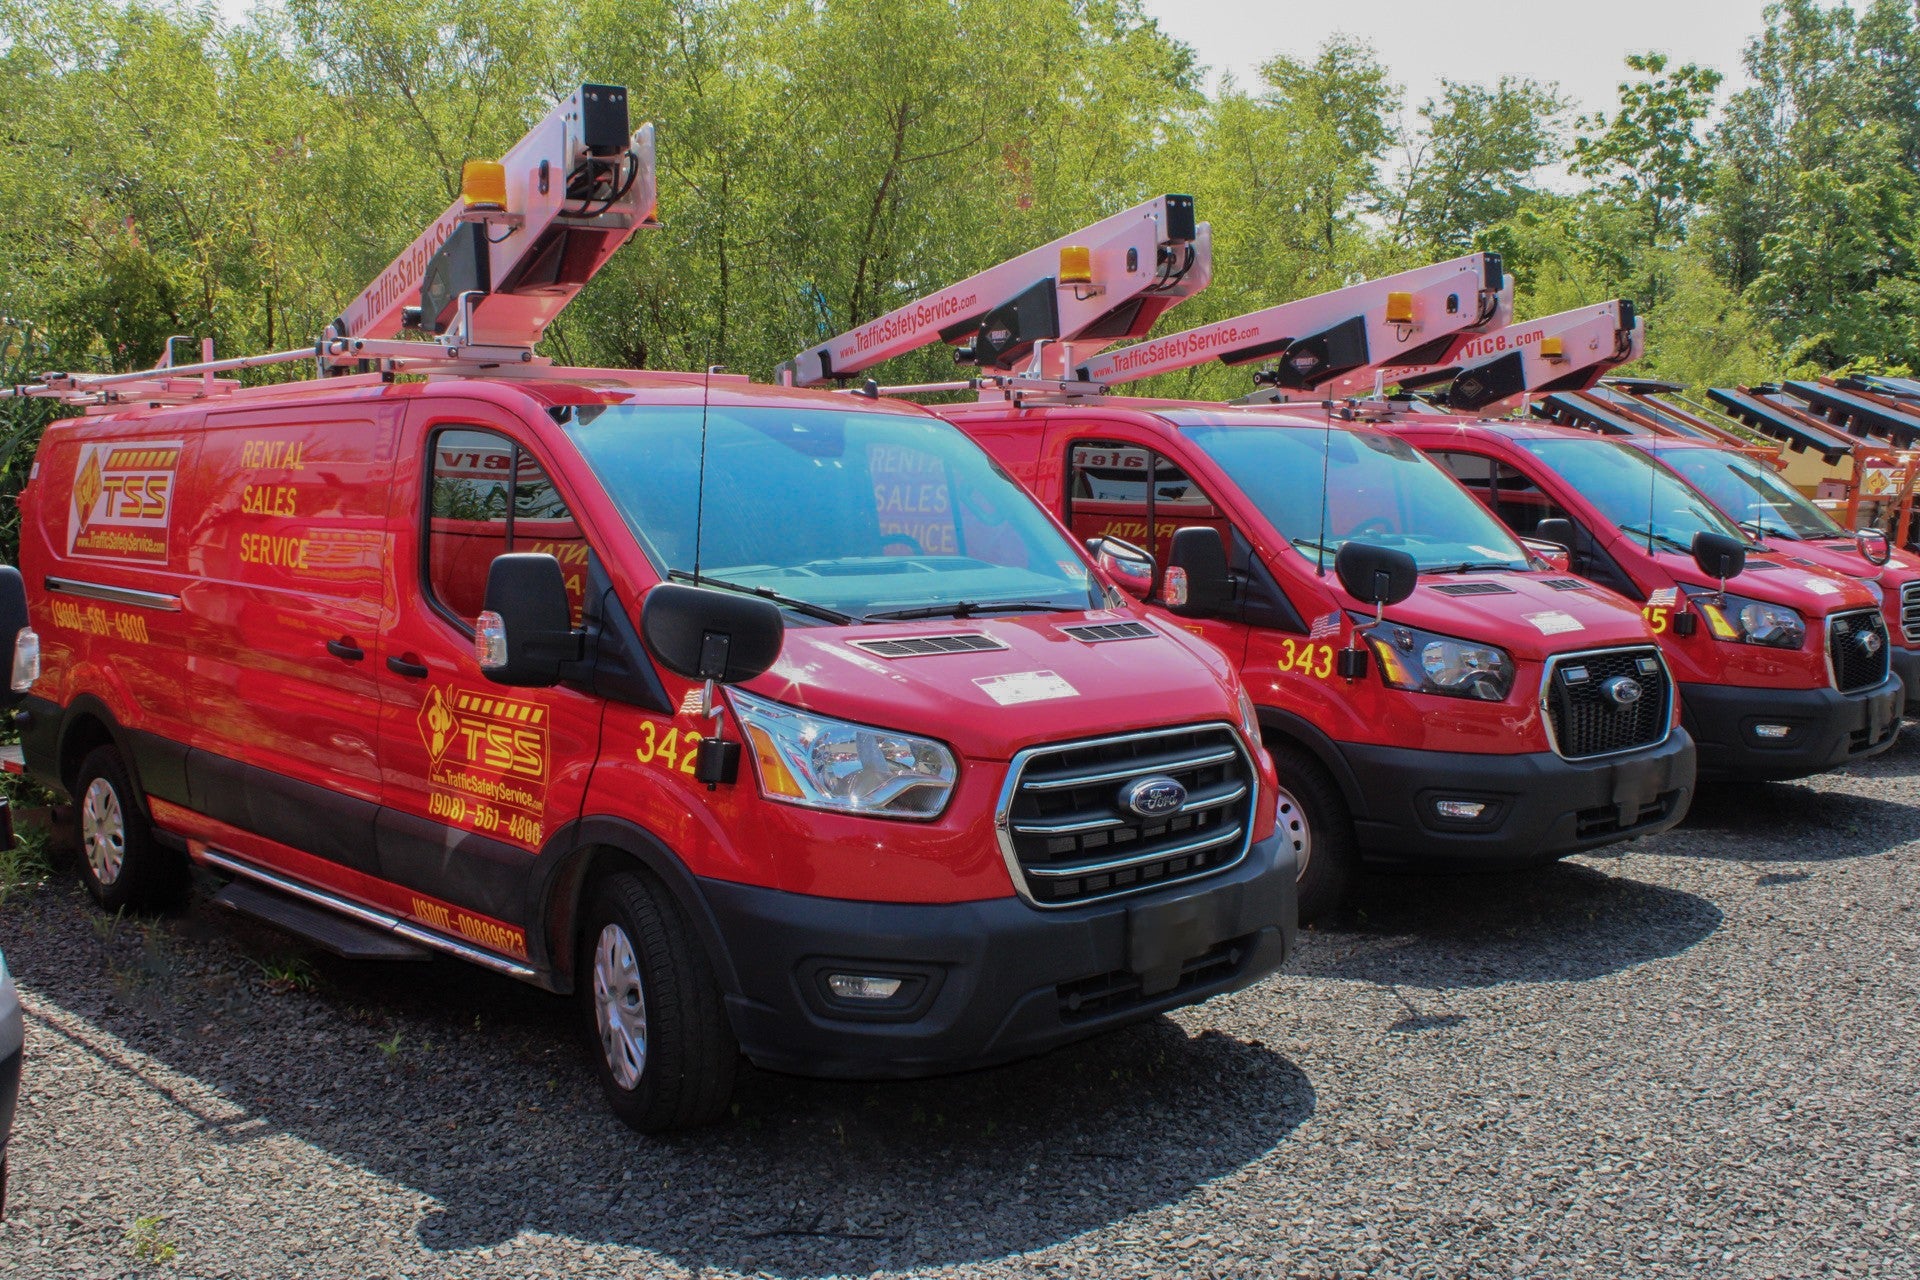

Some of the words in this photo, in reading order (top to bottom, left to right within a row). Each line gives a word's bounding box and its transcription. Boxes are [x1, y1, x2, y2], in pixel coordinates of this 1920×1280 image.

[839, 293, 977, 359] www.TrafficSafetyService.com
[1093, 326, 1259, 378] www.TrafficSafetyService.com
[241, 440, 304, 470] RENTAL
[103, 475, 168, 519] TSS
[242, 485, 297, 516] SALES
[77, 530, 166, 554] www.TrafficSafetyService.com
[240, 533, 309, 569] SERVICE
[1277, 638, 1333, 679] 343
[461, 718, 543, 776] TSS
[636, 720, 704, 775] 342
[432, 769, 544, 811] www.TrafficSafetyService.com
[1147, 787, 1178, 809] Ford
[429, 792, 541, 846] (908)-561-4800
